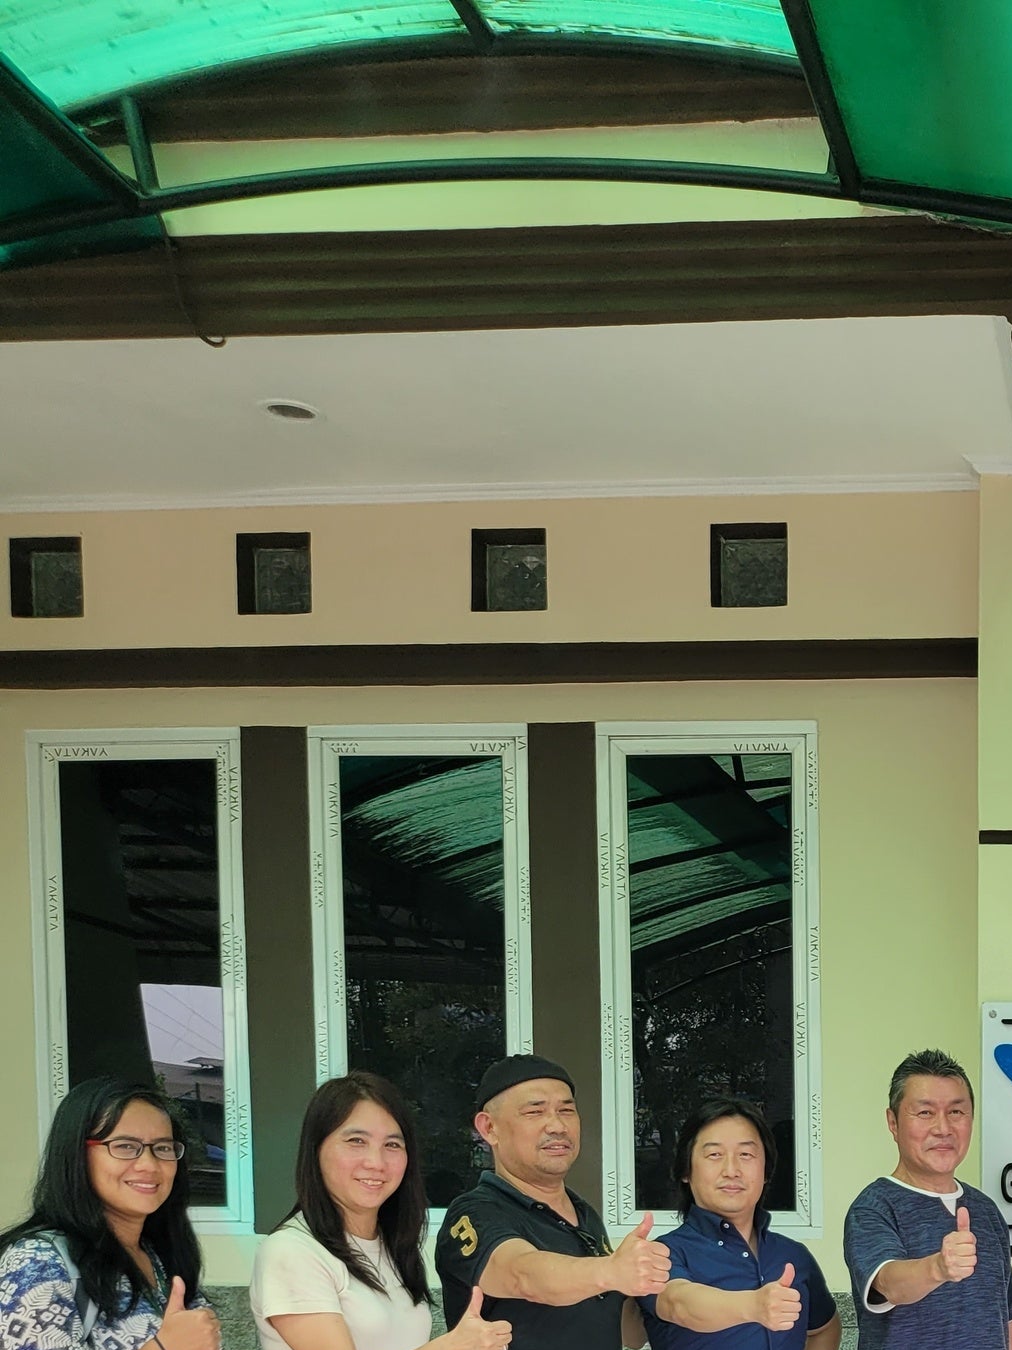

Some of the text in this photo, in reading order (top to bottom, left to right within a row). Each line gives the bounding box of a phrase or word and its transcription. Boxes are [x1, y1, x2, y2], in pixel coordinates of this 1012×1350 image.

[54, 747, 108, 757] YAKATA
[229, 766, 240, 823] YAKATA
[504, 767, 514, 824] YAKATA
[616, 843, 626, 900] YAKATA
[49, 875, 58, 931] YAKATA
[796, 1002, 806, 1058] YAKATA
[450, 1215, 478, 1257] 3
